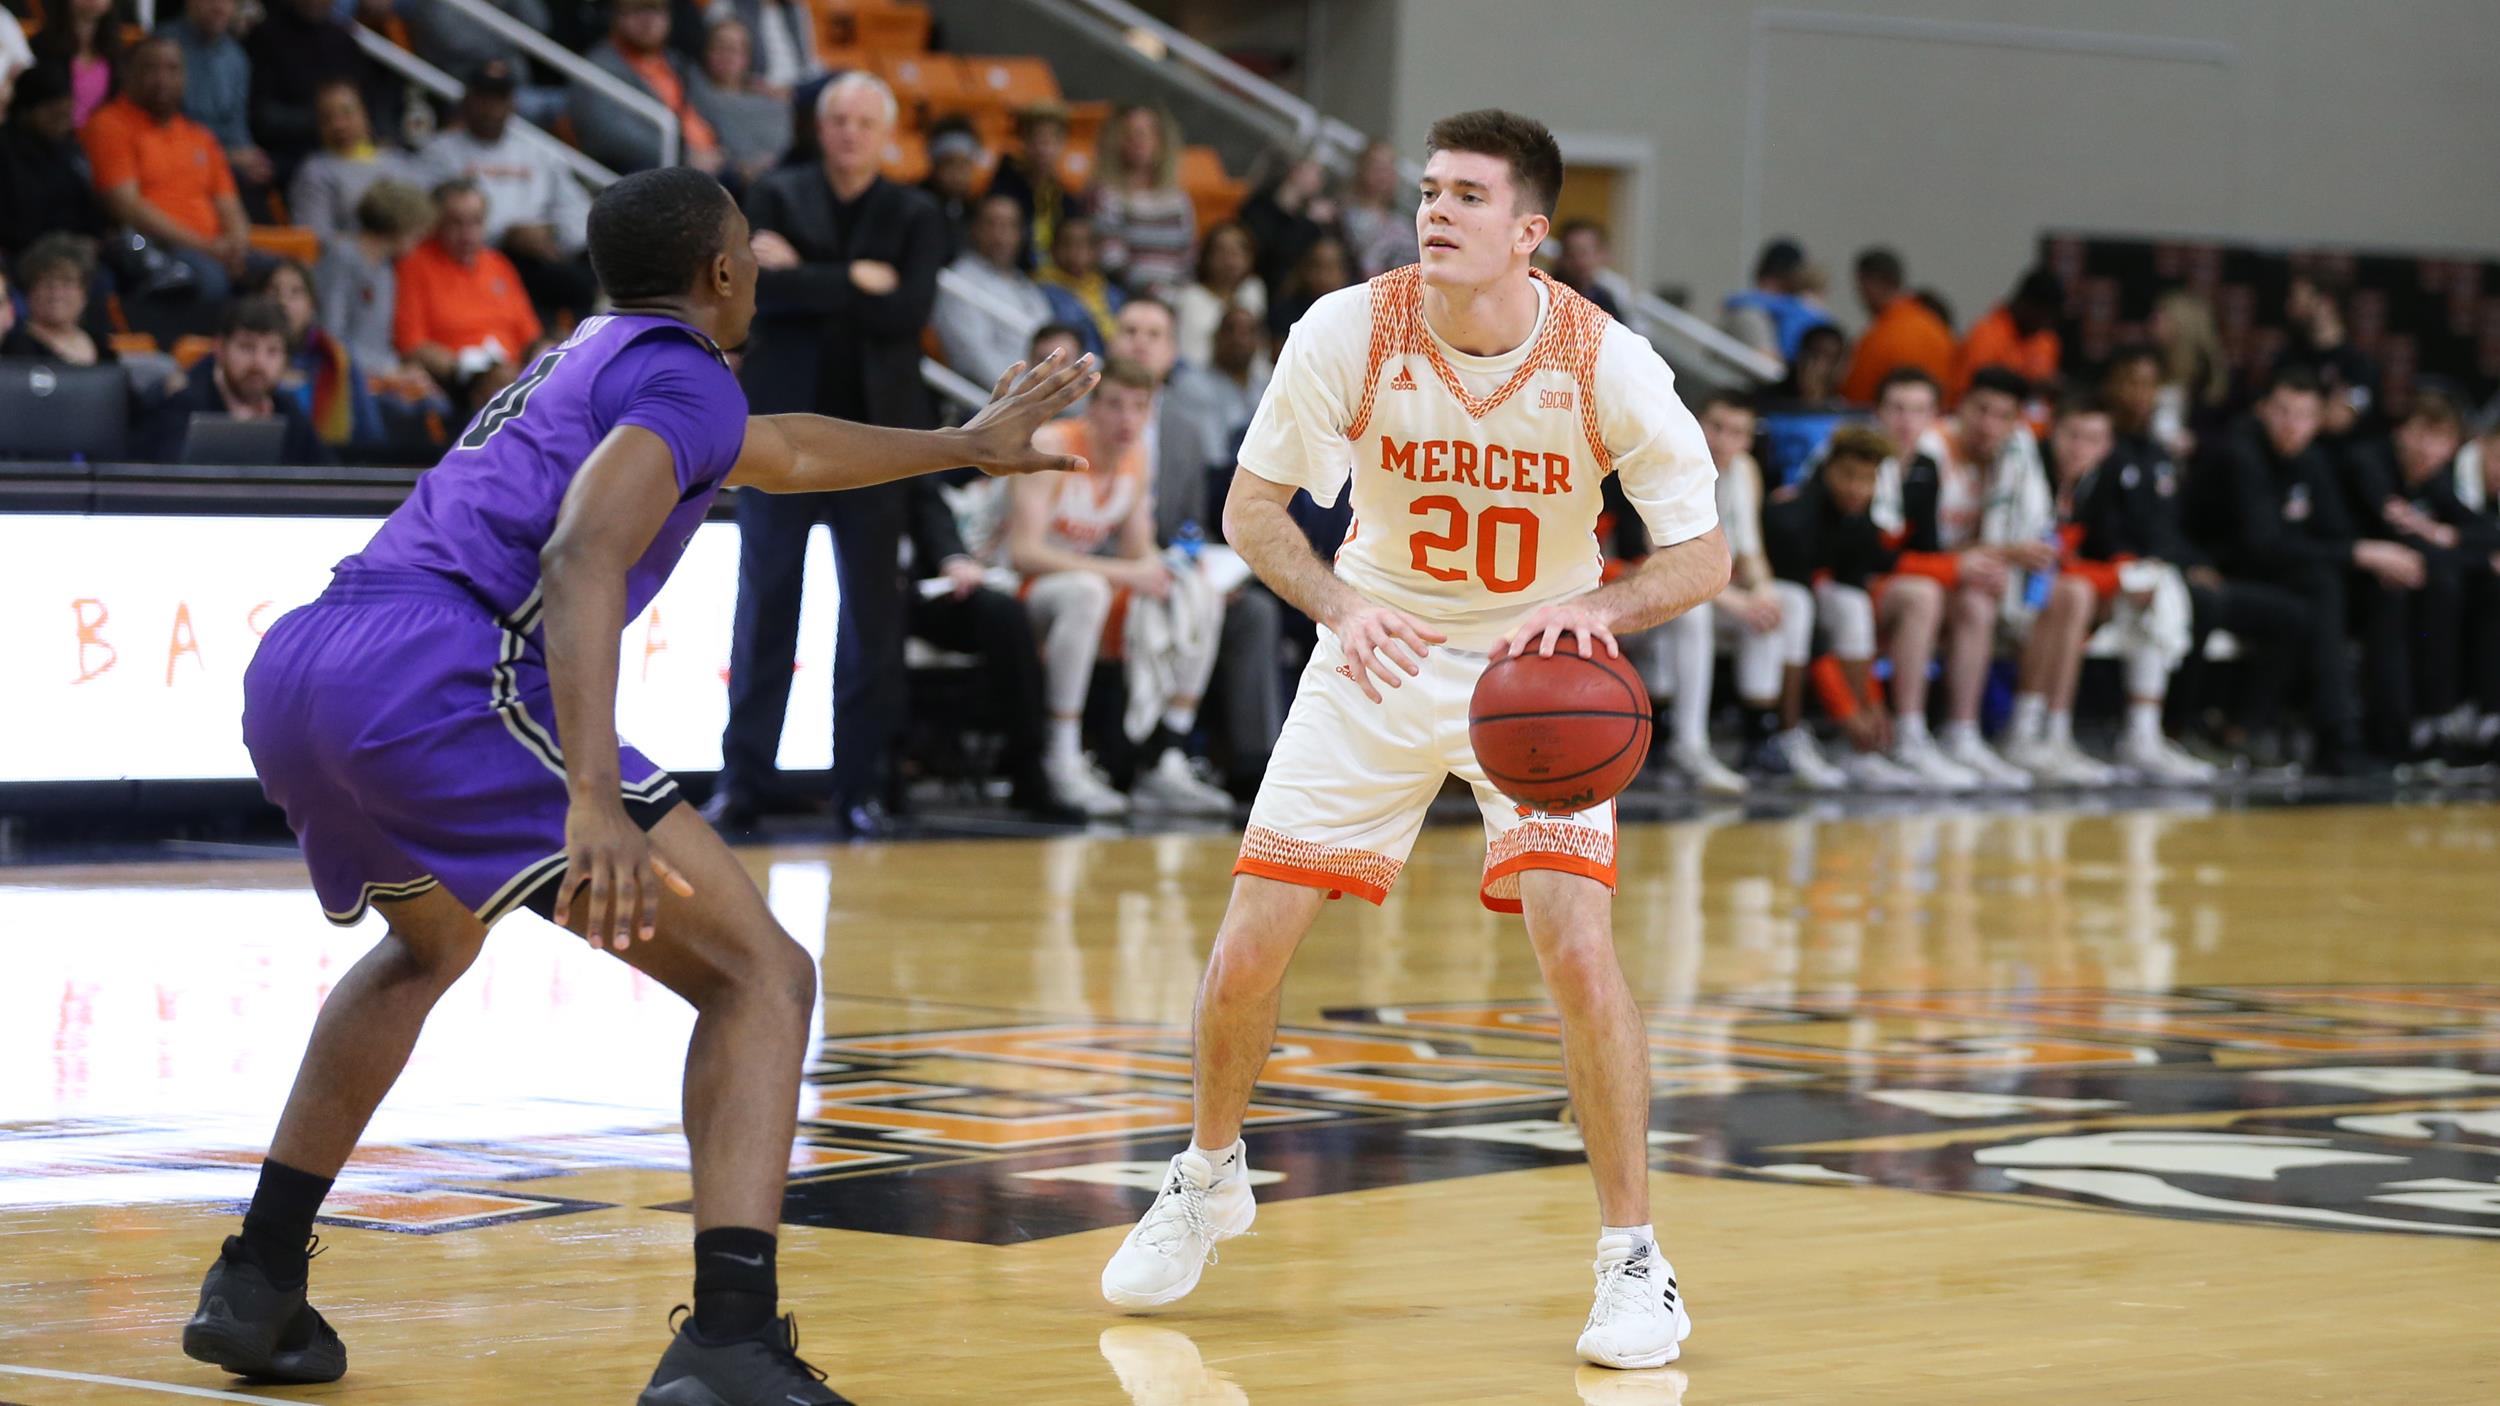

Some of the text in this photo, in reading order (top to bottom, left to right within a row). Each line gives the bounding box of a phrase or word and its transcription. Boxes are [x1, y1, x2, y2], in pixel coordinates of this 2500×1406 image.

[1390, 380, 1418, 391] adidas
[1380, 435, 1573, 495] MERCER
[1409, 494, 1540, 594] 20
[1335, 665, 1357, 682] adi
